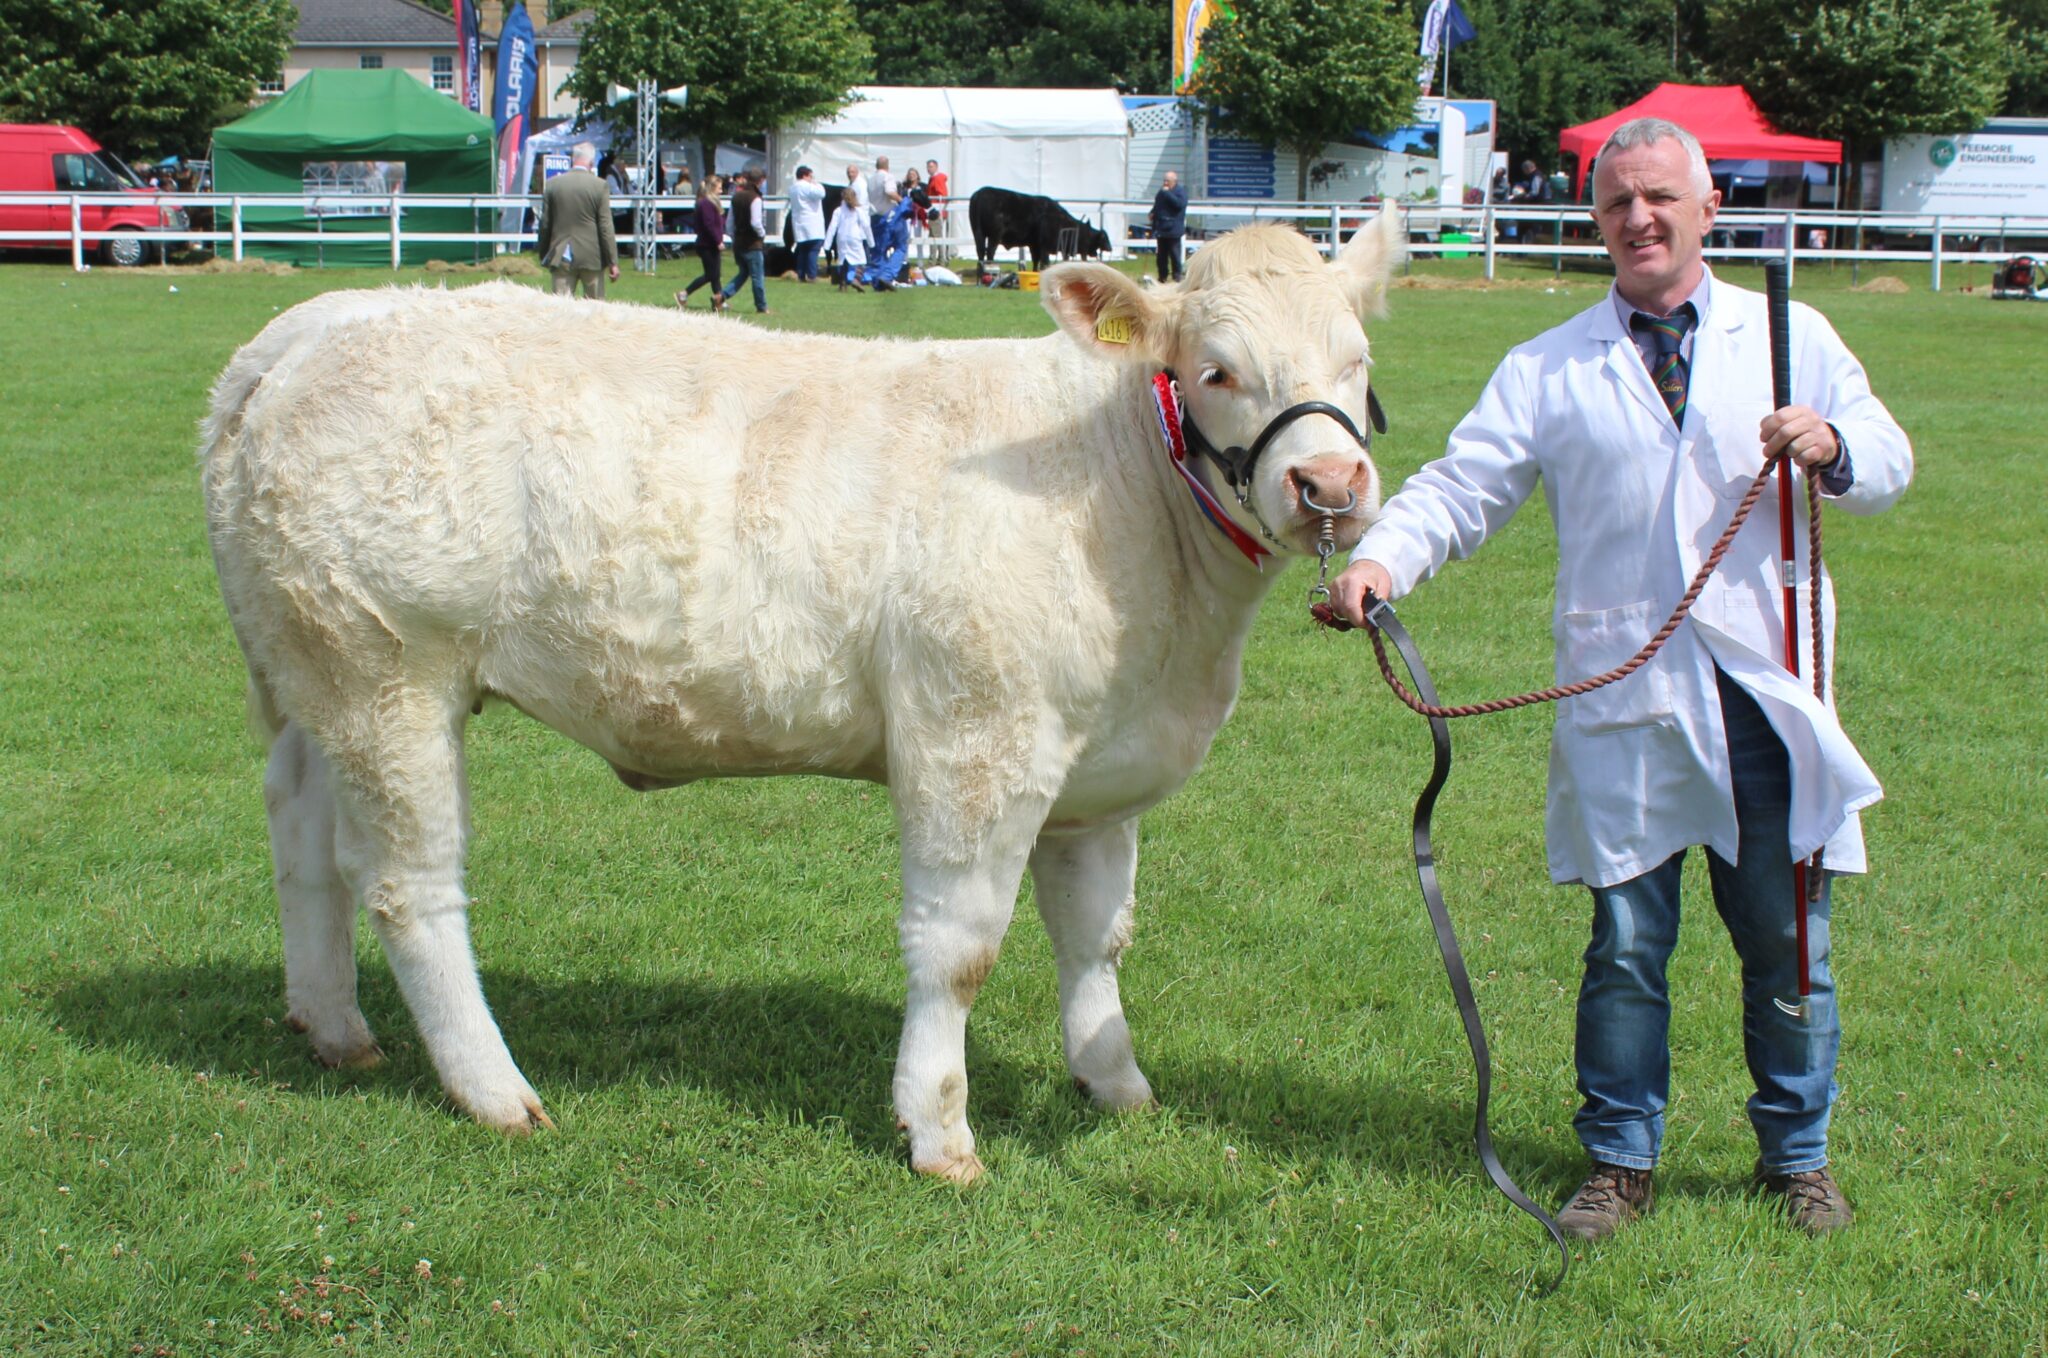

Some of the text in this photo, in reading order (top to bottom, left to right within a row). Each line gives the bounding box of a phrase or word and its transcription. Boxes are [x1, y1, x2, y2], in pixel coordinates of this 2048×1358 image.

[506, 36, 526, 119] OLARIS
[1960, 143, 2014, 153] TEEMORE
[1960, 154, 2036, 164] ENGINEERING
[545, 159, 570, 170] RING
